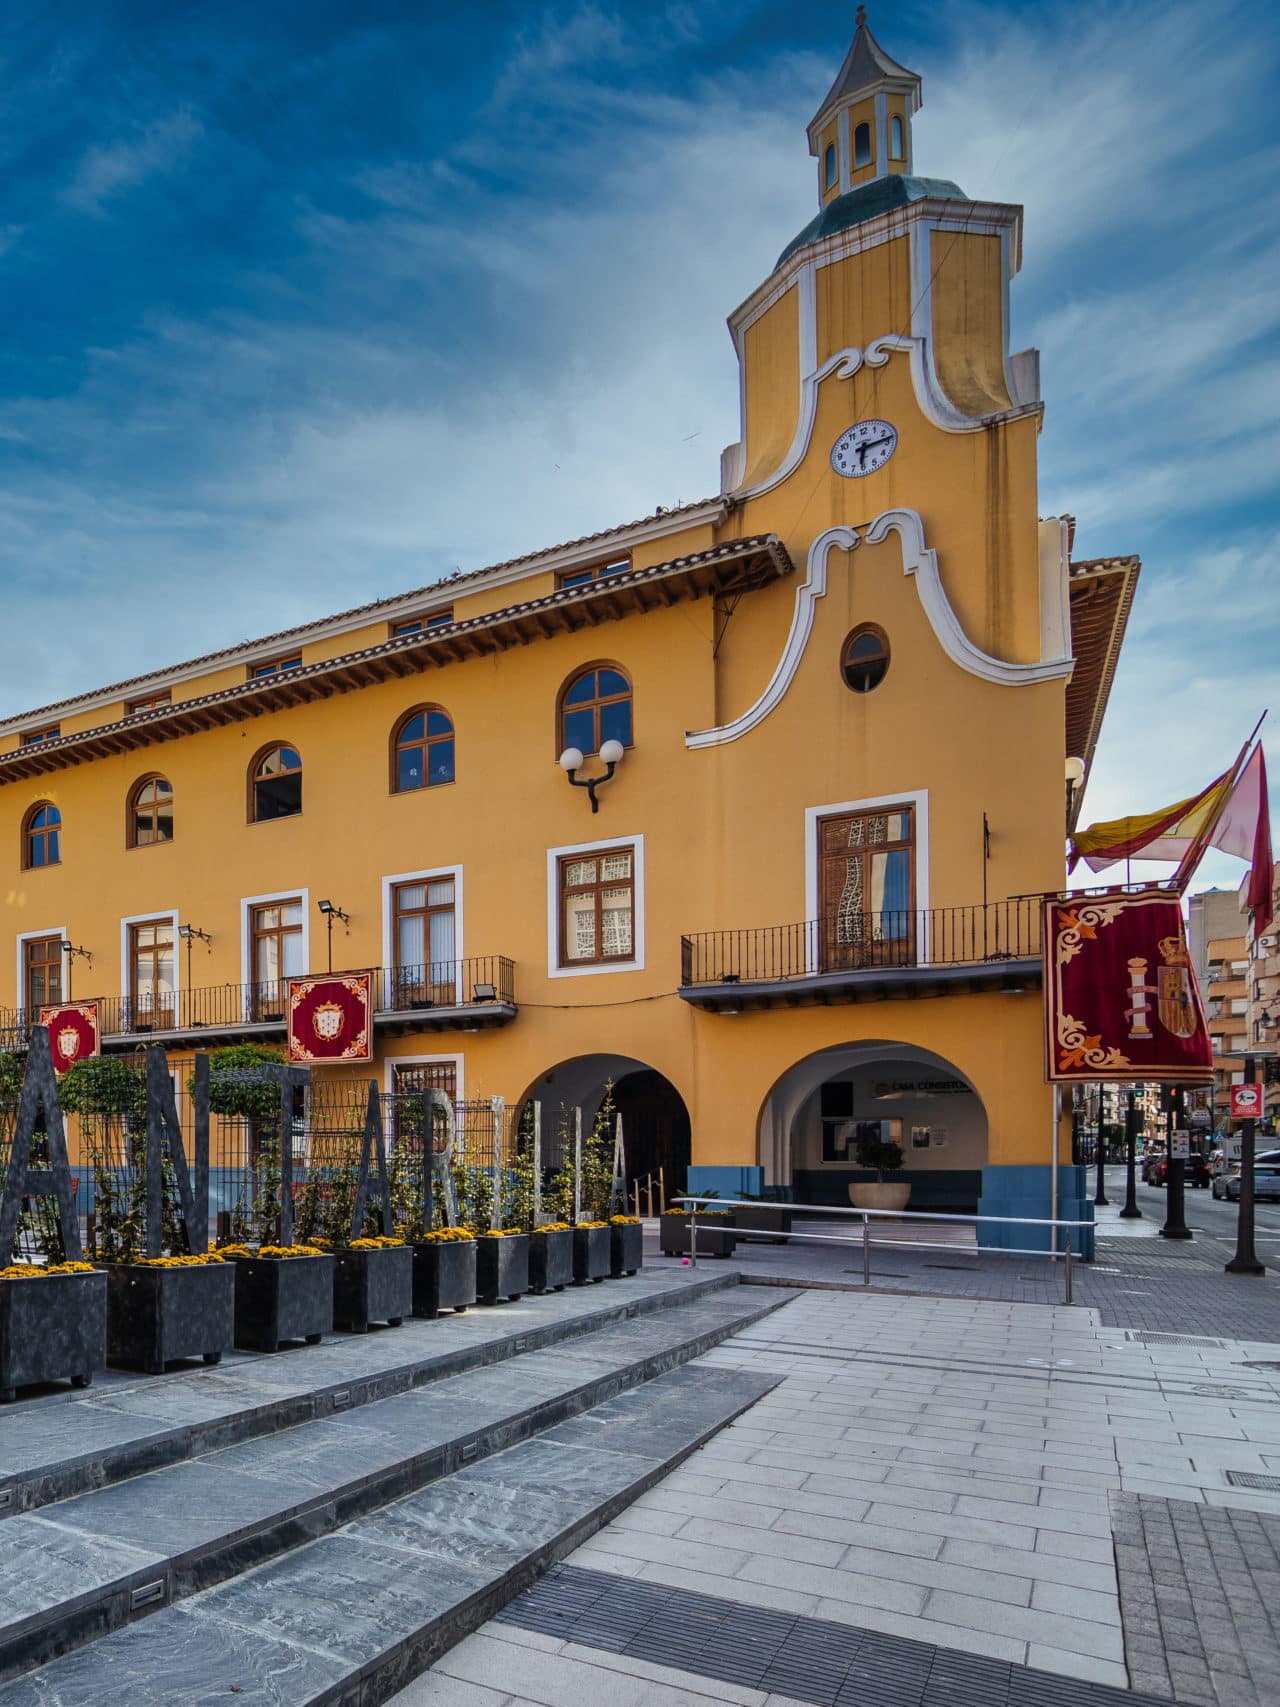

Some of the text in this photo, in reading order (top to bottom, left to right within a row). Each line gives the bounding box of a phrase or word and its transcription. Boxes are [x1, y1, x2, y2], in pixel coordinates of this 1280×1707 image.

[860, 427, 868, 435] 12
[880, 429, 887, 437] 2
[849, 432, 856, 440] 11
[841, 442, 849, 450] 10
[838, 452, 843, 460] 9
[842, 460, 847, 468] 8
[872, 458, 878, 466] 5
[851, 464, 857, 472] 7
